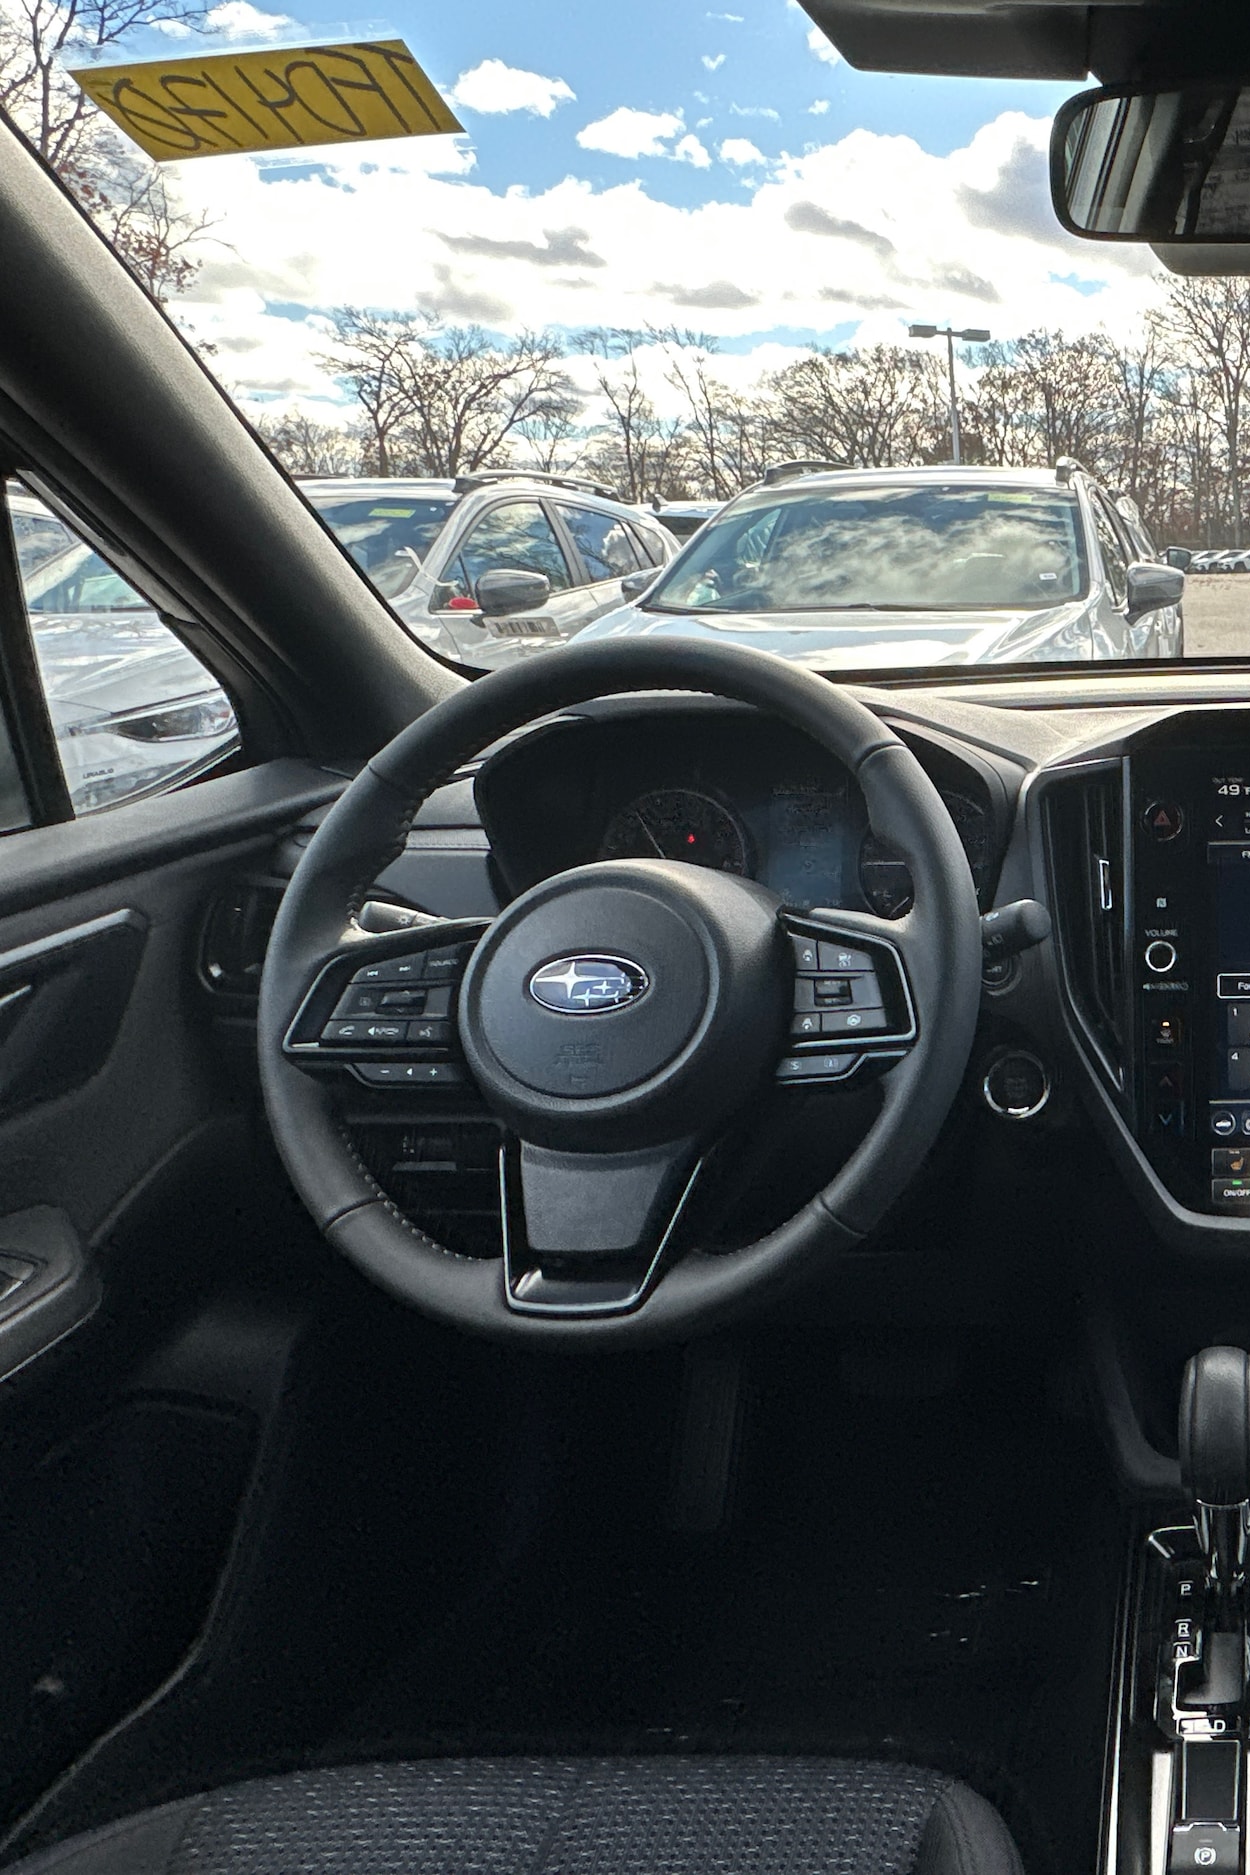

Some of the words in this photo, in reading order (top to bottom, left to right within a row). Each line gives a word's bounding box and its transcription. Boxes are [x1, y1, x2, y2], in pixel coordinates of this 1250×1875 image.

[1217, 784, 1240, 796] 49
[1145, 929, 1178, 937] VOLUME
[1231, 1052, 1239, 1061] 4
[1223, 1188, 1250, 1197] ON/OFF
[1180, 1583, 1191, 1595] P
[1178, 1622, 1189, 1635] R
[1176, 1645, 1188, 1657] N
[1213, 1719, 1226, 1733] D
